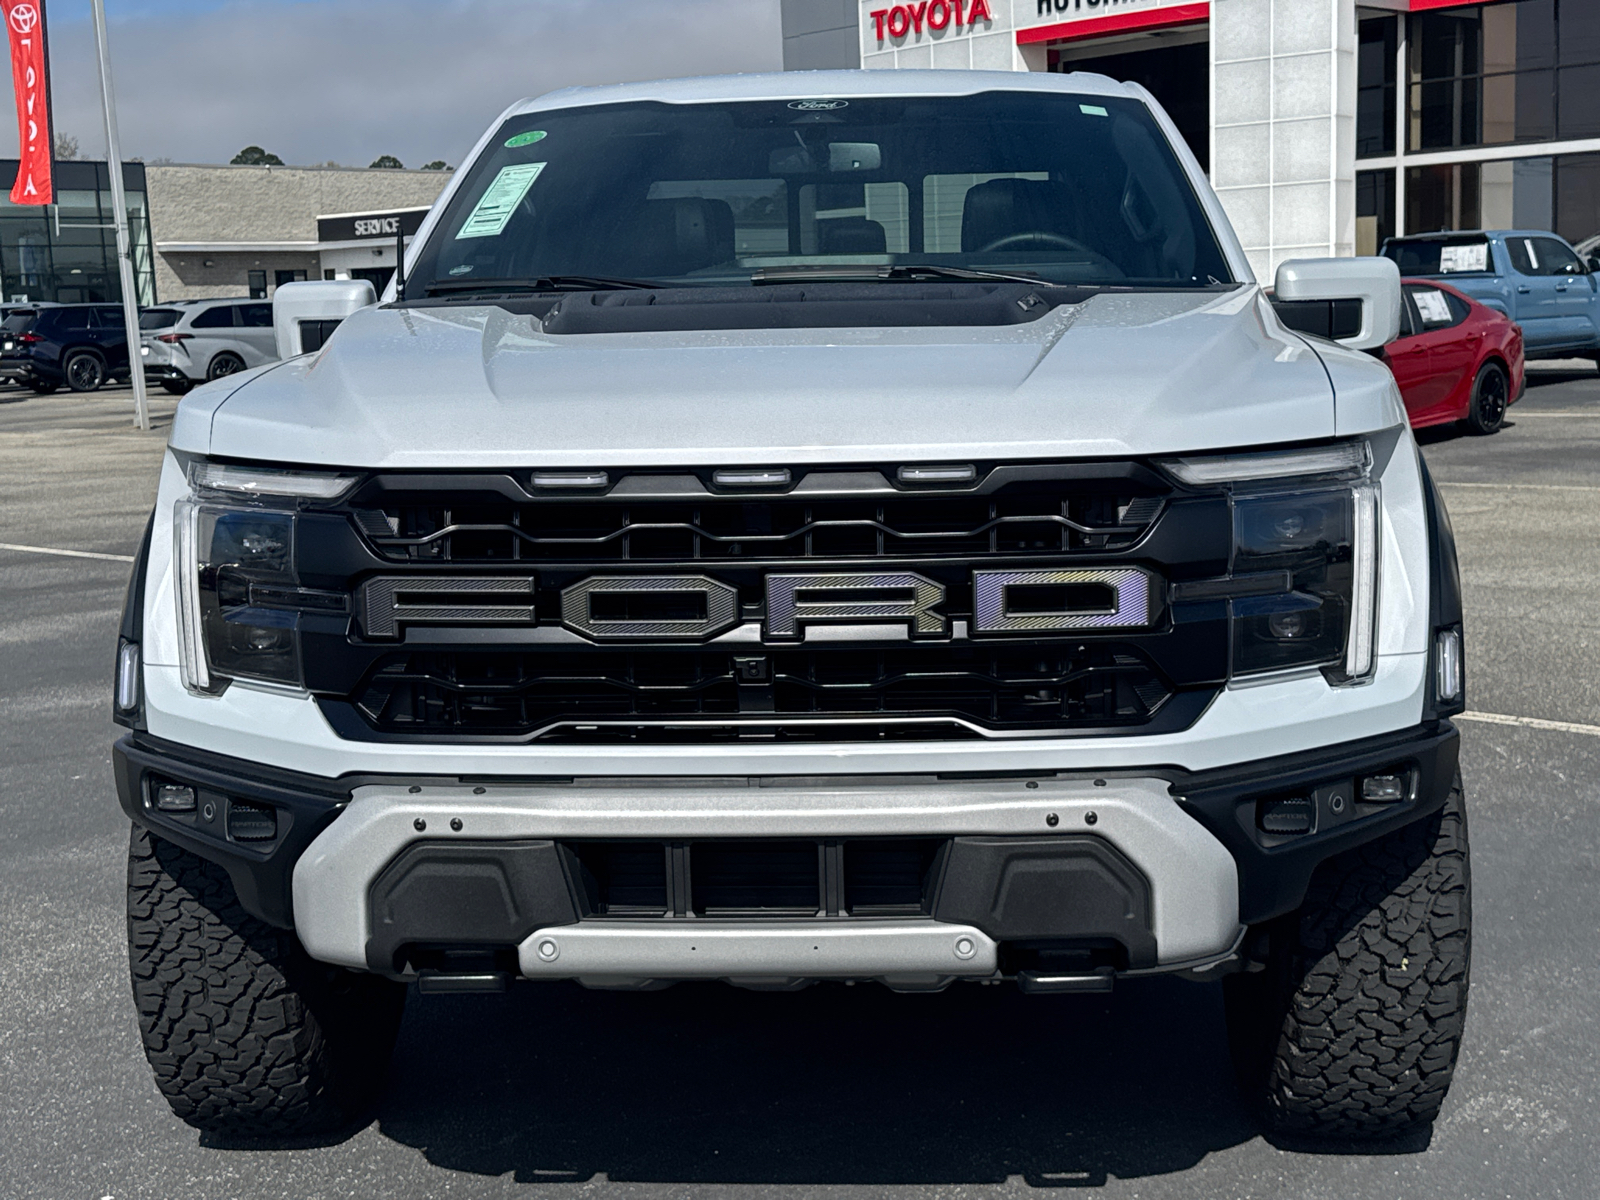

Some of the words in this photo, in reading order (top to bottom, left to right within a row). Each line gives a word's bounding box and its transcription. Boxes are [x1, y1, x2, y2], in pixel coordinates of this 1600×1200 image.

[870, 0, 992, 41] TOYOTA
[21, 38, 38, 196] TOYOA
[797, 101, 838, 109] Ford
[354, 217, 400, 236] SERVICE
[364, 565, 1150, 638] FORD
